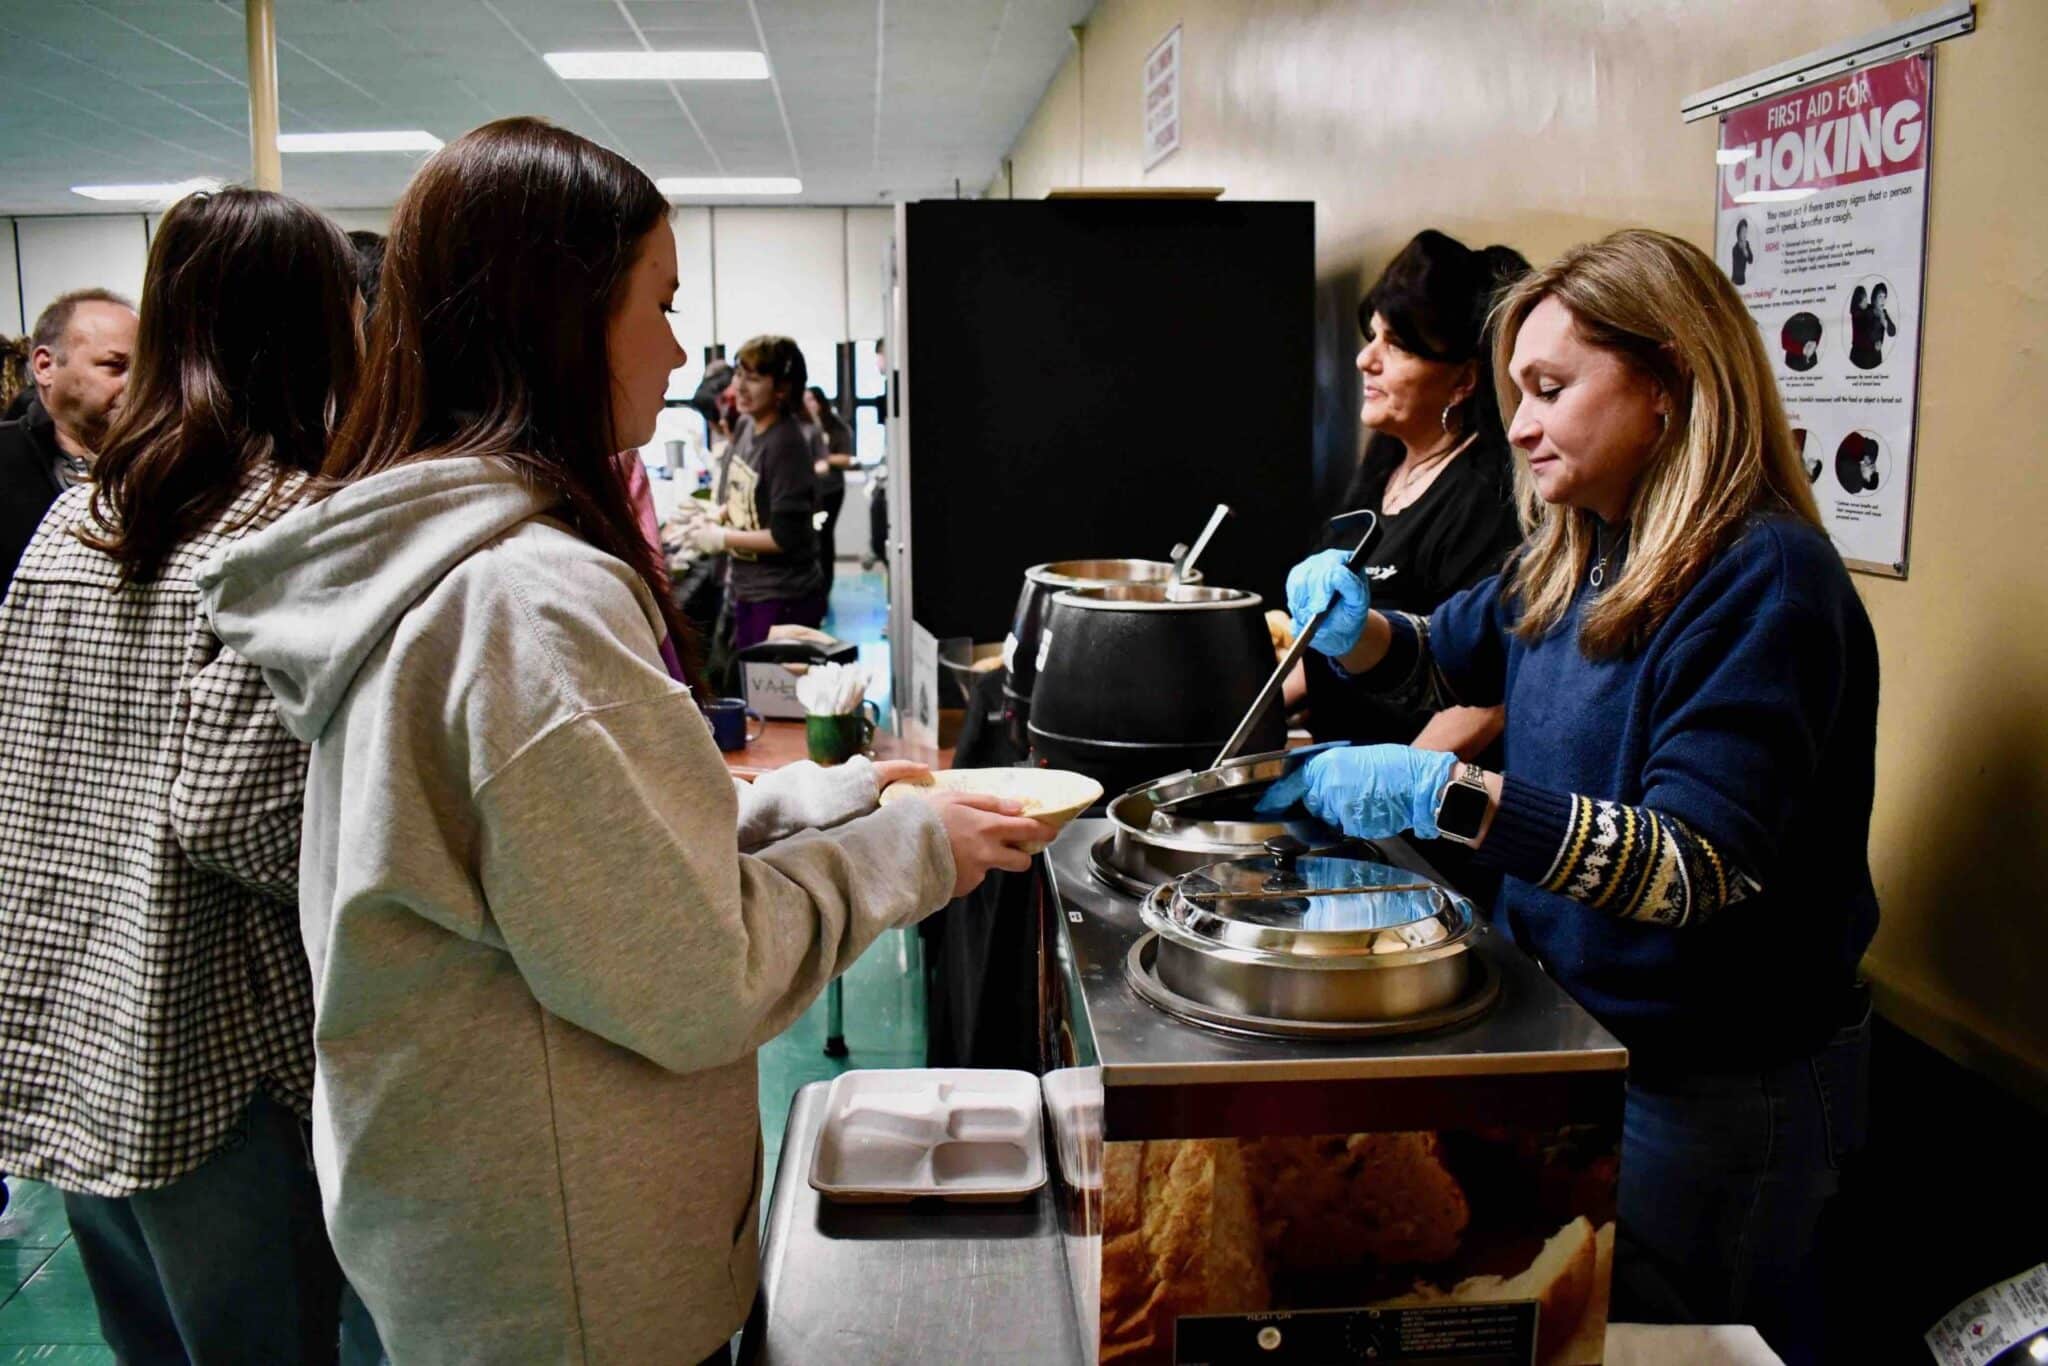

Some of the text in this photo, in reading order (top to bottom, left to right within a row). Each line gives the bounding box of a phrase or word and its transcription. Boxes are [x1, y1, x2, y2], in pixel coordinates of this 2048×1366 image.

[1768, 80, 1869, 131] FIRST AID FOR
[1725, 99, 1922, 202] CHOKING
[1809, 202, 1823, 213] there
[1824, 202, 1835, 210] are
[1836, 199, 1848, 209] any
[1868, 189, 1881, 201] that
[1889, 185, 1913, 201] person
